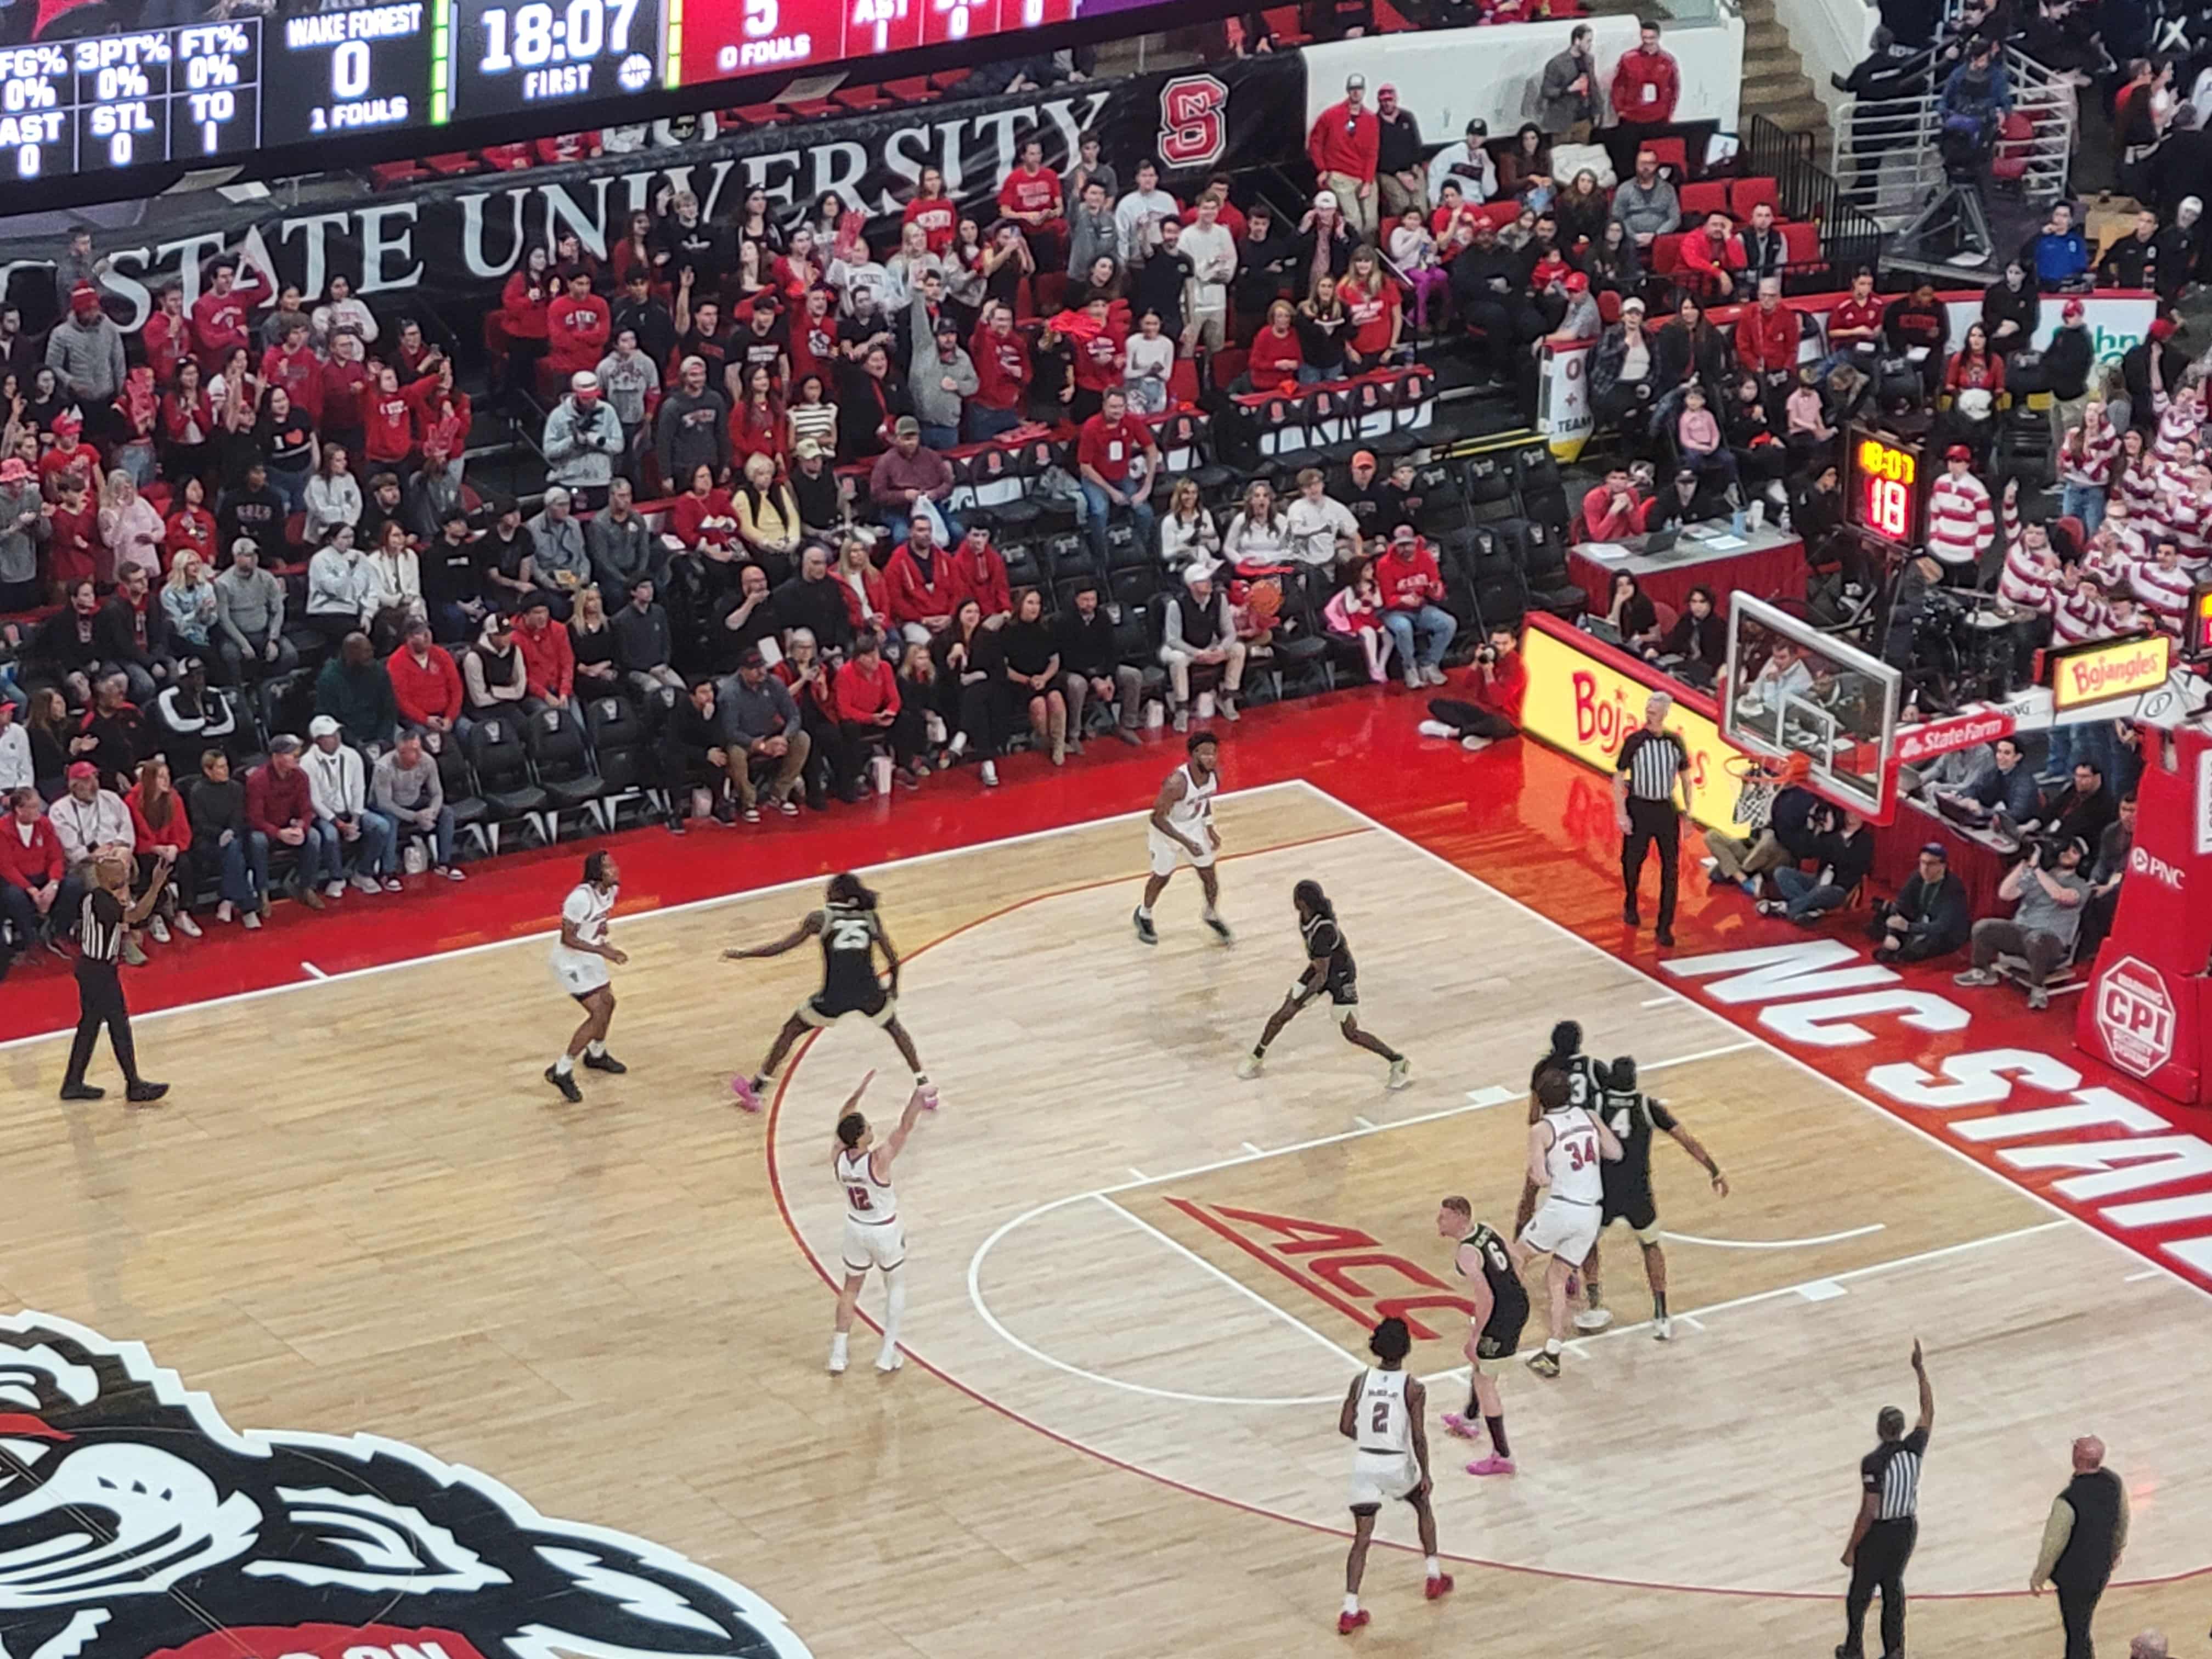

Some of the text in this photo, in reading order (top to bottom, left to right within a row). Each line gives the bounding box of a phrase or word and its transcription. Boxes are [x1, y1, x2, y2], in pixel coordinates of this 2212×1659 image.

[180, 25, 248, 59] FT%
[287, 2, 423, 50] WAKE FOREST
[479, 0, 639, 74] 18:07
[76, 35, 171, 71] 3PT%
[718, 34, 811, 70] 0 FOULS
[98, 65, 148, 100] 0%
[188, 54, 238, 89] 0%
[332, 40, 370, 100] 0
[524, 63, 592, 102] FIRST
[5, 76, 56, 111] 0%
[189, 91, 235, 123] TO
[0, 112, 65, 147] AST
[91, 102, 154, 136] STL
[309, 95, 408, 134] 1 FOULS
[18, 144, 40, 178] 0
[110, 132, 132, 166] 0
[98, 202, 424, 333] STATE
[1871, 477, 1906, 534] 18
[2072, 650, 2160, 696] Bojangles
[2149, 856, 2186, 890] PNC
[832, 919, 870, 949] 25
[1659, 938, 1971, 1047] NC
[2106, 988, 2168, 1046] CPI
[1610, 1108, 1632, 1139] 4
[1564, 1136, 1597, 1171] 34
[1865, 1047, 2212, 1281] STA
[847, 1186, 874, 1211] 12
[1488, 1240, 1508, 1272] 6
[1373, 1402, 1390, 1434] 2
